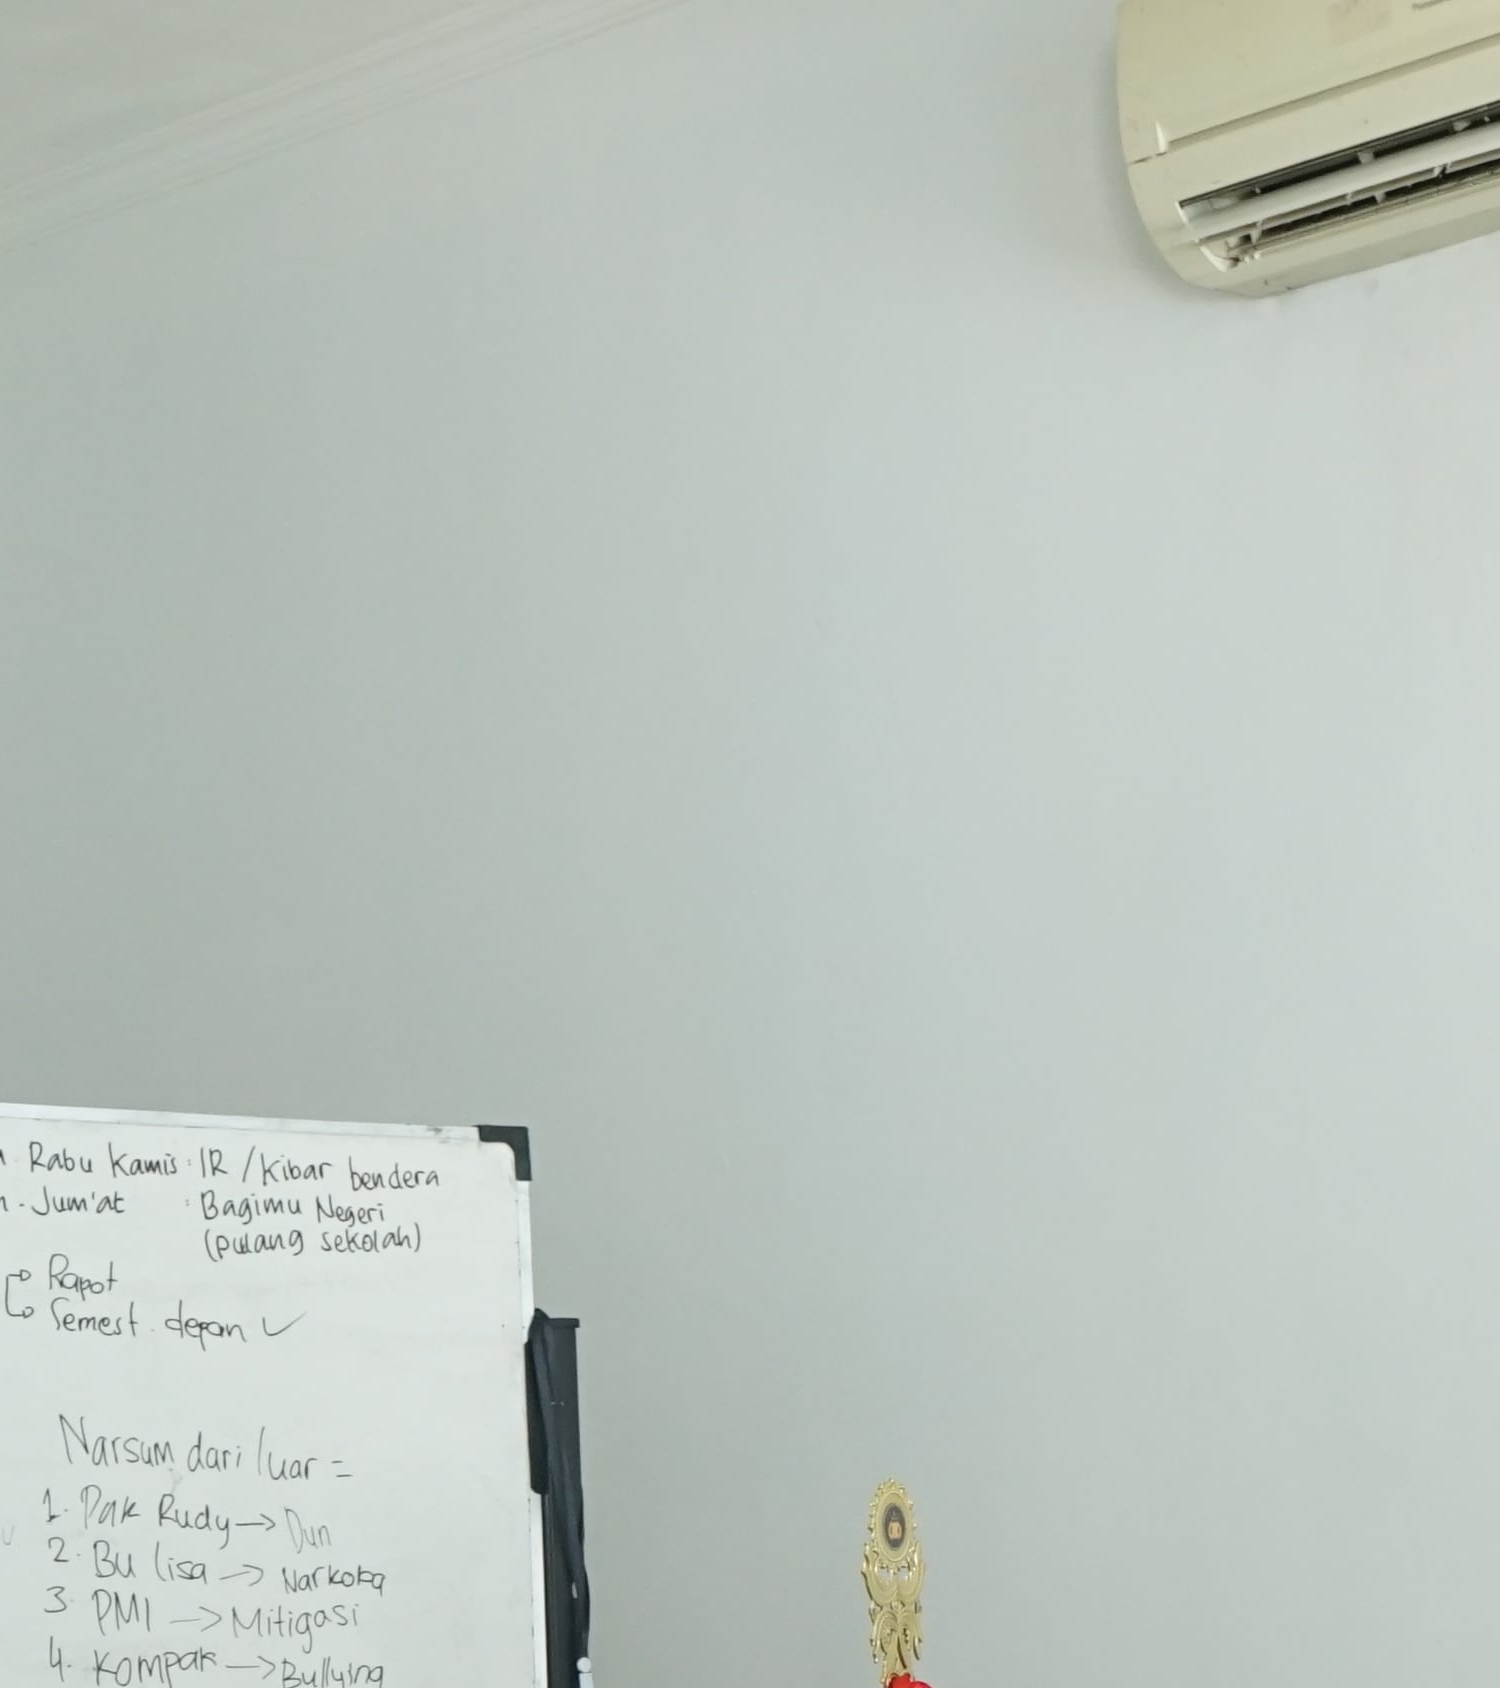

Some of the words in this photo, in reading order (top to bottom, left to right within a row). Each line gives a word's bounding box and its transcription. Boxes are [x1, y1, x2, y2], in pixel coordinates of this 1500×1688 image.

[29, 1140, 94, 1174] Rabu
[348, 1155, 440, 1192] bendera
[200, 1190, 303, 1226] Bagimu
[315, 1194, 386, 1228] Negeri
[48, 1253, 118, 1302] Rapot
[165, 1299, 248, 1351] depan
[187, 1430, 243, 1473] dari
[258, 1426, 318, 1481] luar
[80, 1484, 141, 1530] Pak
[158, 1493, 231, 1550] Rudy
[93, 1539, 137, 1579] Bu
[282, 1563, 386, 1597] Narkoba
[91, 1588, 152, 1637] PMI
[231, 1602, 360, 1654] Mitigasi
